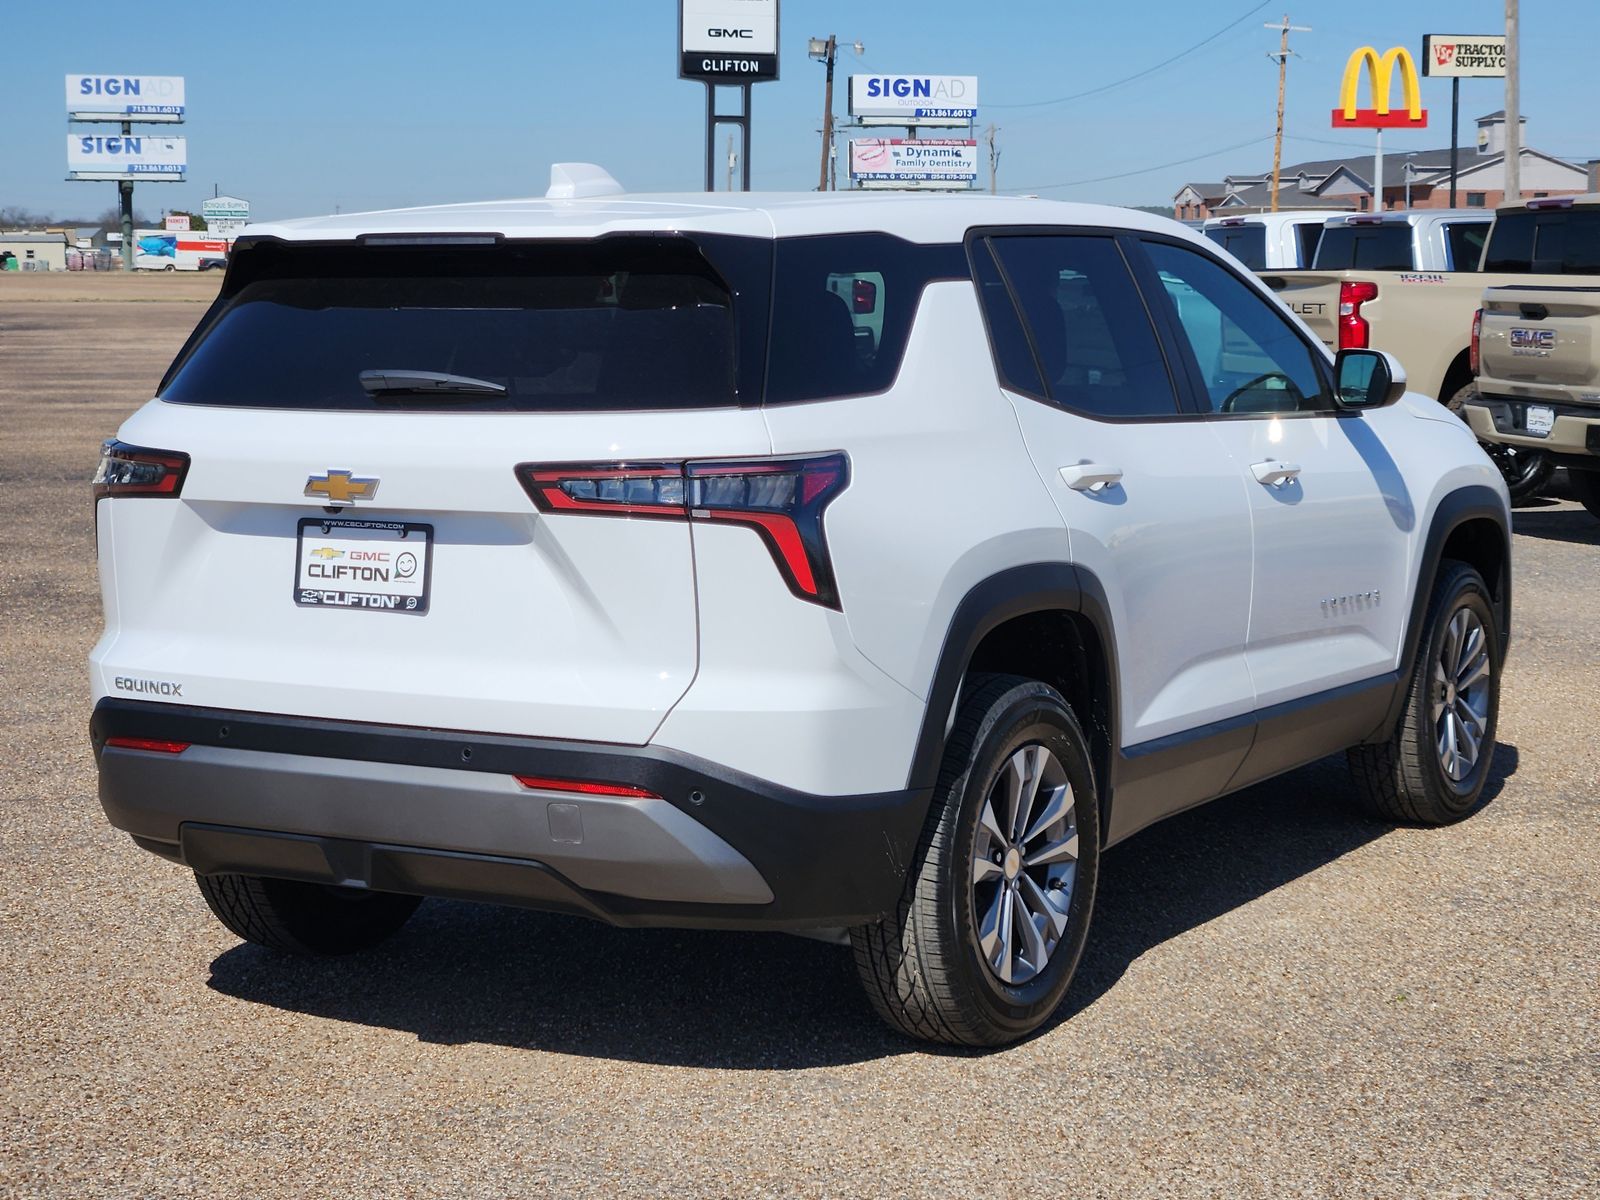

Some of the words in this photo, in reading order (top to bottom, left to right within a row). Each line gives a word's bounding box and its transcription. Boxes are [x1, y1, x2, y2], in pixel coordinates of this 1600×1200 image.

[708, 28, 753, 39] GMC
[702, 59, 759, 73] CLIFTON
[1455, 56, 1497, 68] SUPPLY
[921, 109, 972, 117] 713.861.6013
[906, 147, 962, 158] Dynamic
[896, 159, 926, 168] Family
[929, 160, 972, 168] Dentistry
[1285, 303, 1326, 315] LET
[1511, 329, 1553, 349] GMC
[349, 551, 390, 562] GMC
[308, 563, 390, 583] CLIFTON
[323, 591, 395, 608] CLIFTON
[115, 676, 183, 697] EQUINOX
